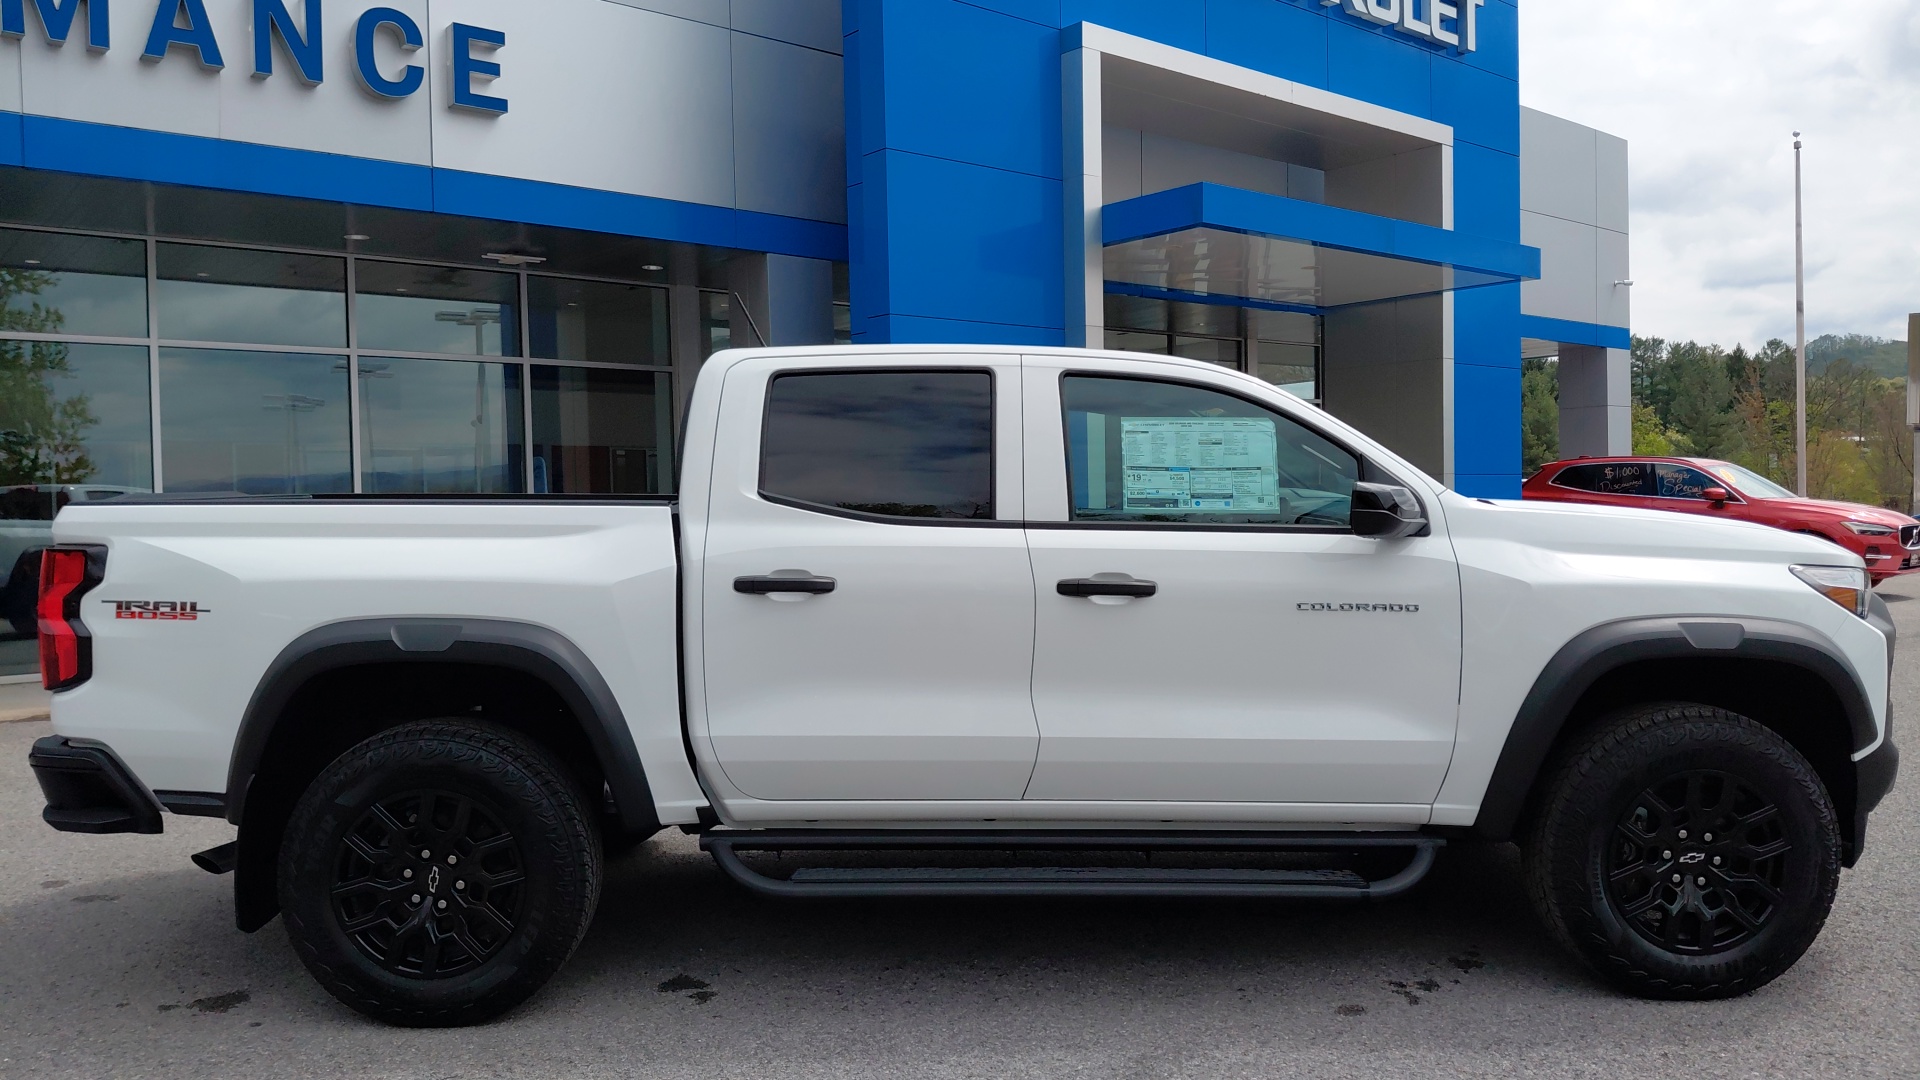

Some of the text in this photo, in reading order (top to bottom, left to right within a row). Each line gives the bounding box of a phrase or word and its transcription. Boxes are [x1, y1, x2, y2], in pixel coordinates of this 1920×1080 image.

[1320, 0, 1484, 52] LET
[101, 600, 211, 612] TRAIL
[1296, 602, 1420, 613] COLORADO
[115, 611, 198, 621] BOSS
